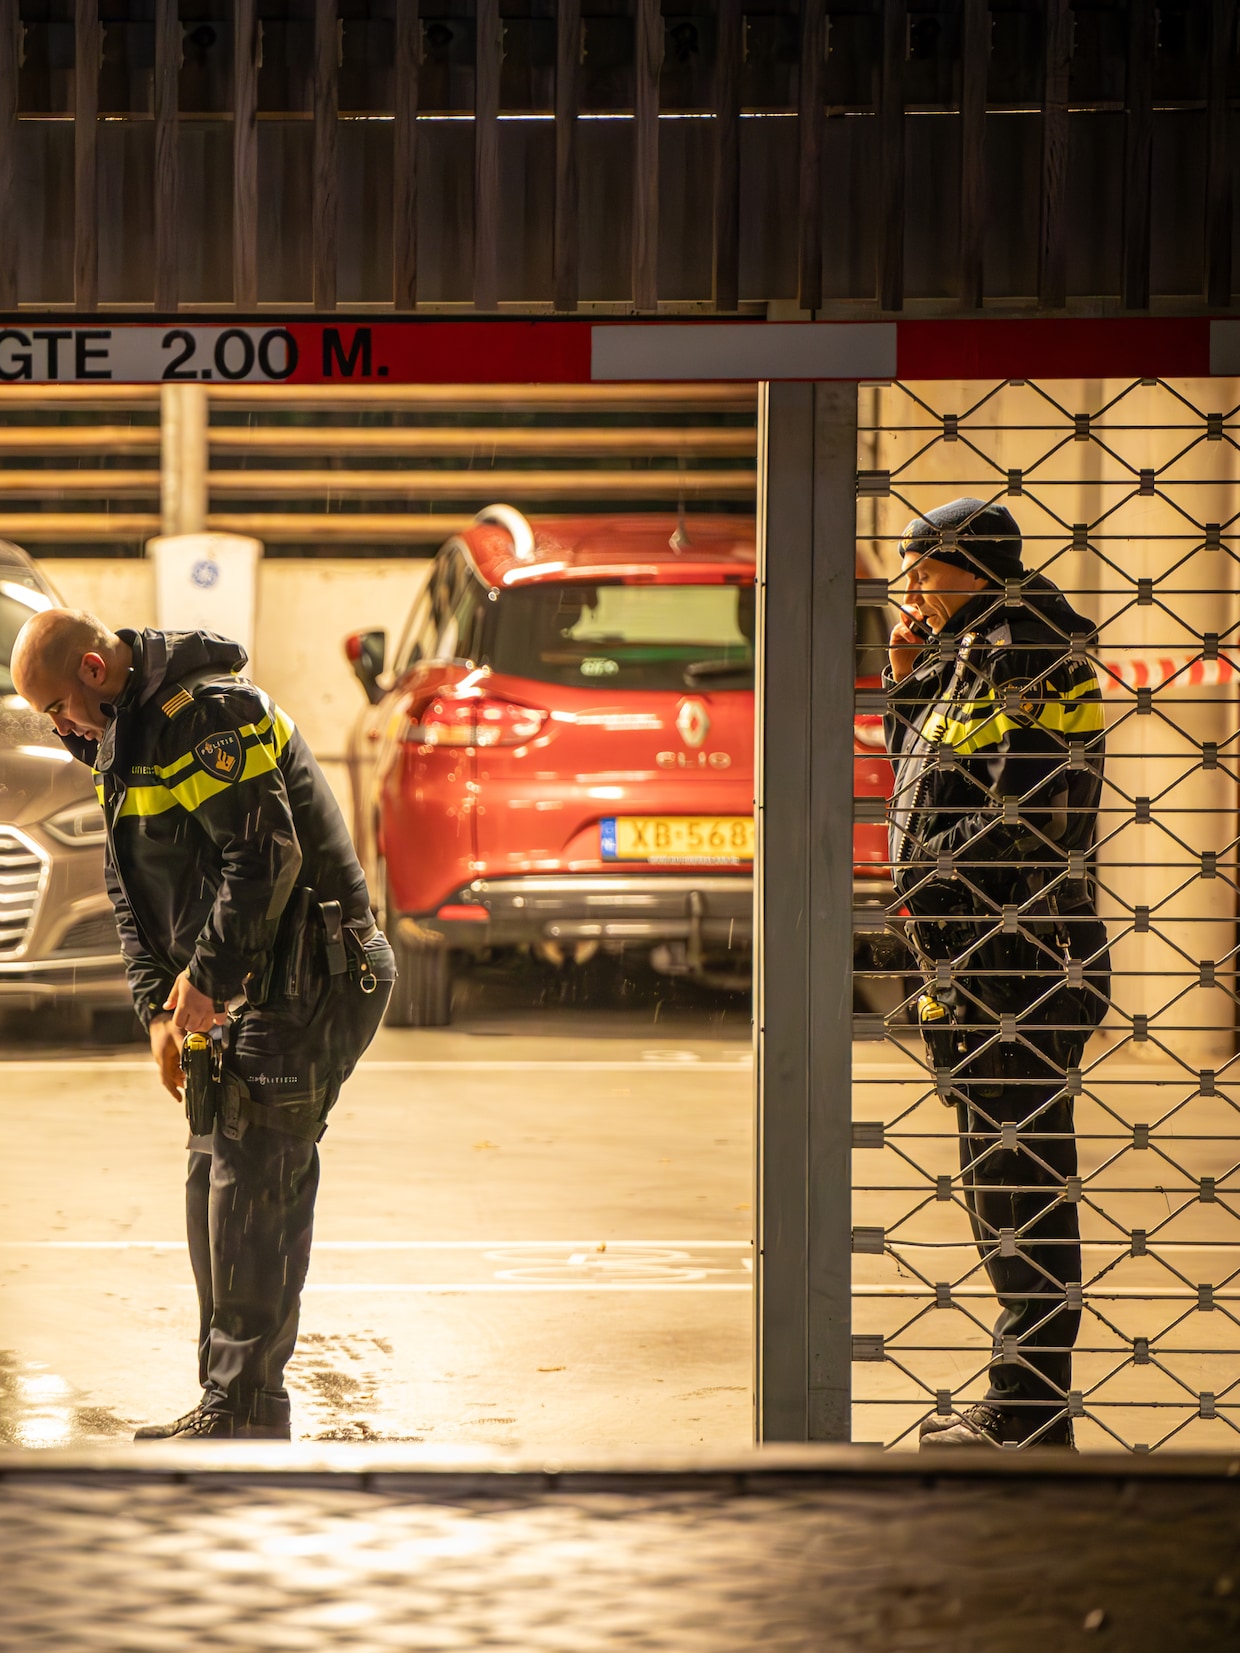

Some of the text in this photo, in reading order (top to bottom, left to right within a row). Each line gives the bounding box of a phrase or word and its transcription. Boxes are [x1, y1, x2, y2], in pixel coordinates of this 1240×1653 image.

[161, 328, 298, 381] 2.00
[321, 328, 390, 378] M.
[655, 750, 732, 769] CLIO
